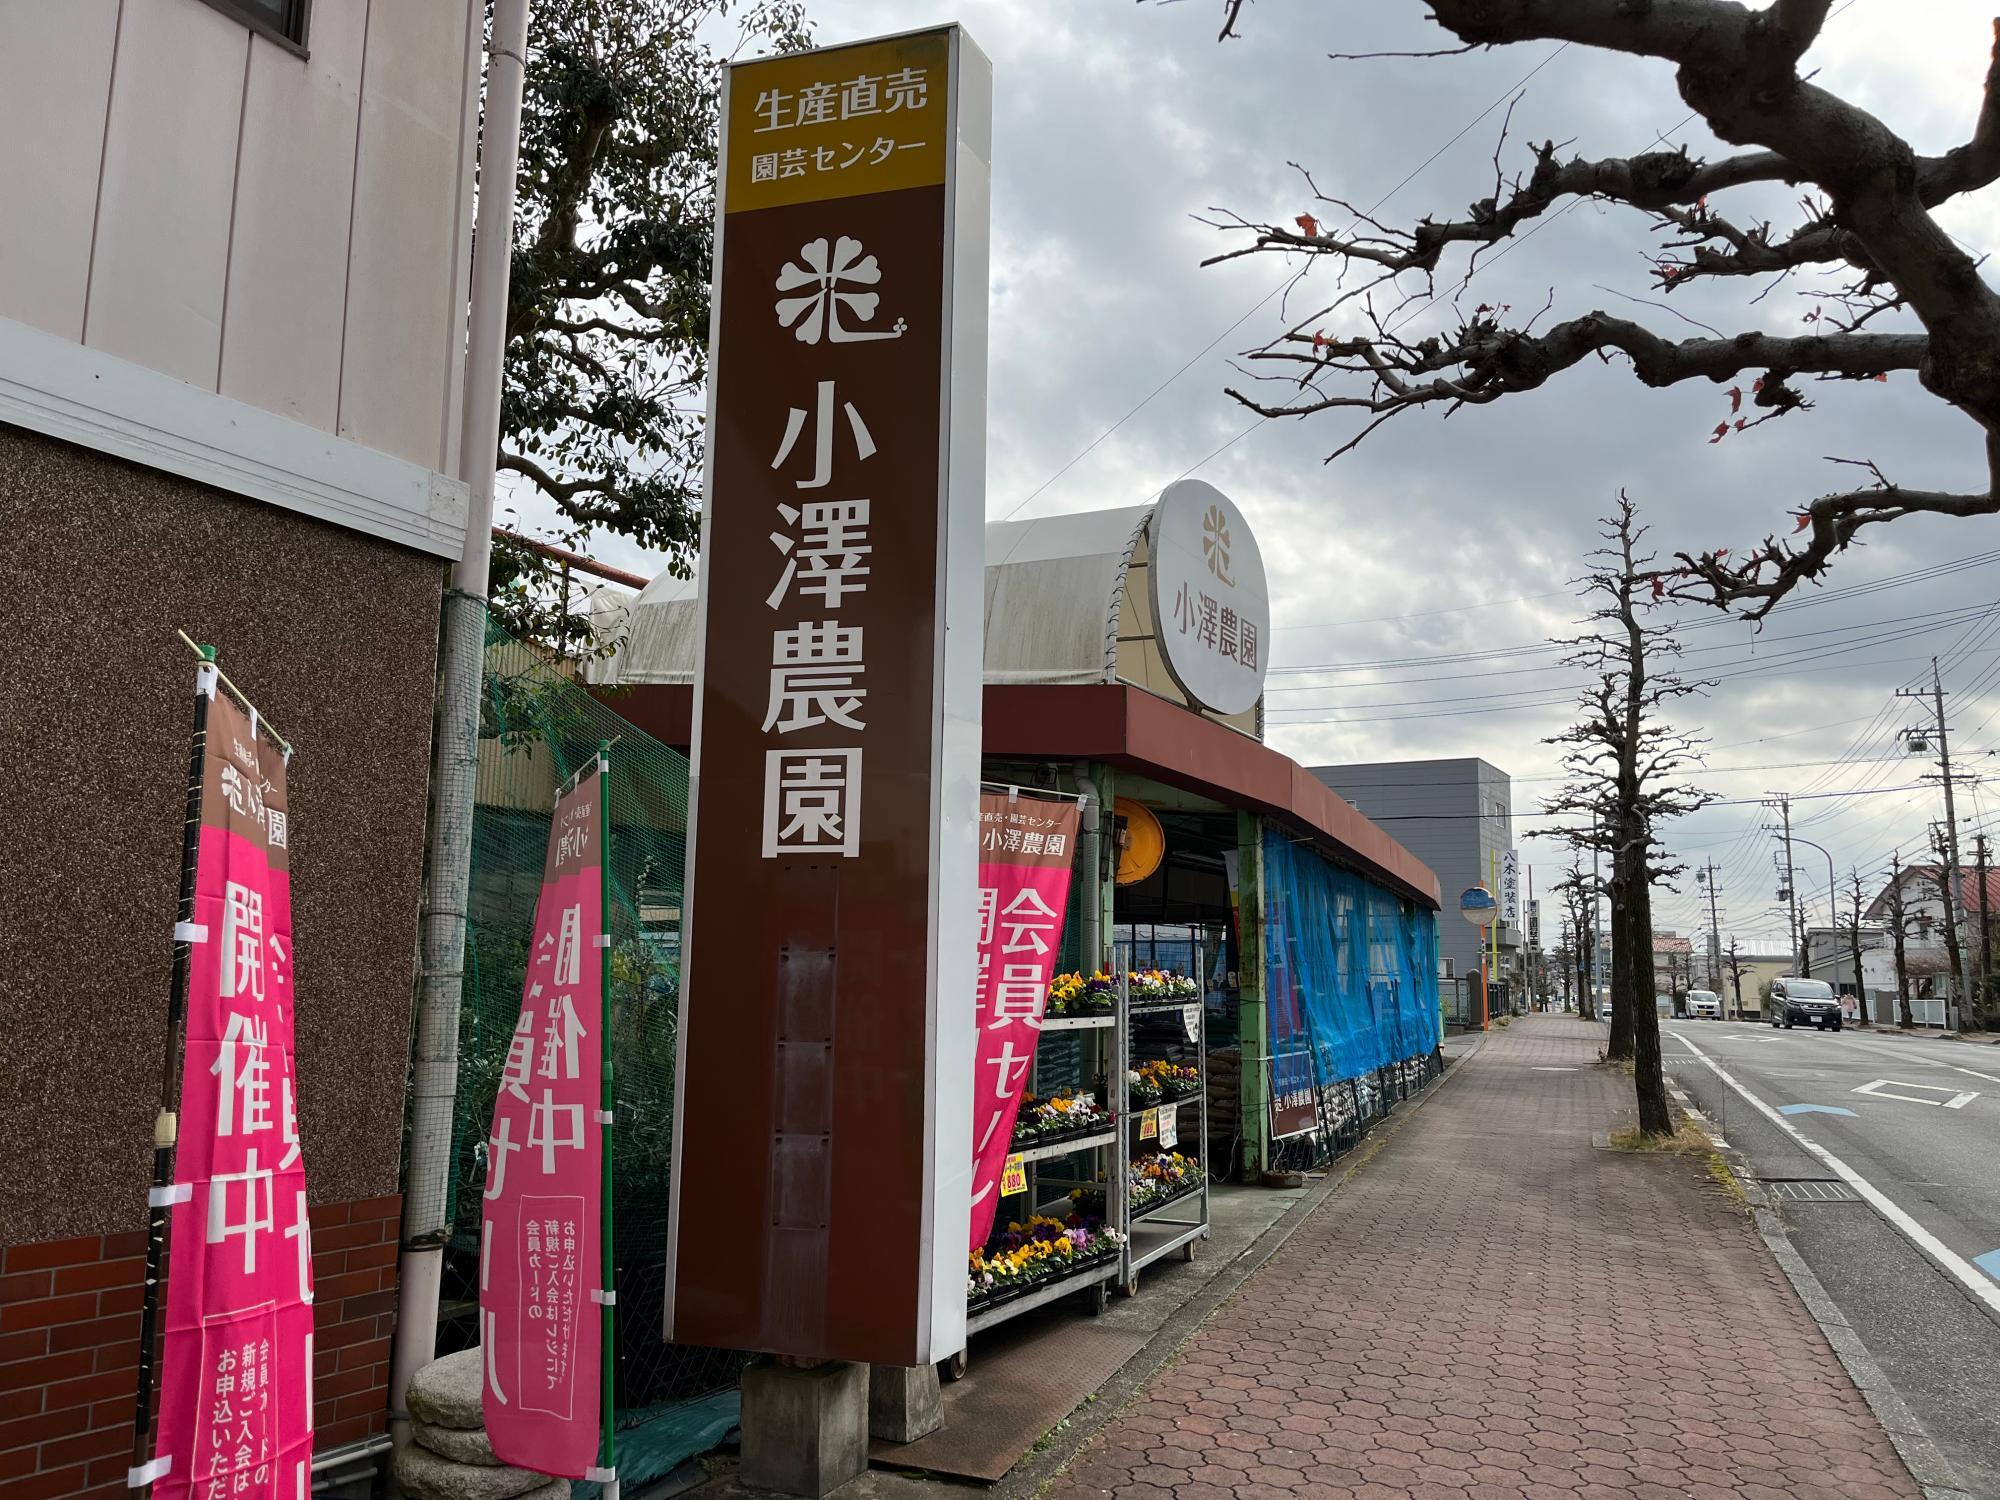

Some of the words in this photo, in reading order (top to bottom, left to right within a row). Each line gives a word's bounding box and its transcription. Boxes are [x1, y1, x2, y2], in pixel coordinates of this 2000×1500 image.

[753, 67, 928, 133] 生産直売
[751, 136, 927, 184] 園芸センター
[761, 380, 877, 859] 小澤農園
[1173, 581, 1258, 673] 小澤農園
[982, 827, 1067, 857] 小澤農園
[1503, 851, 1517, 919] 八木塗装店
[206, 879, 275, 1276] 開催中
[233, 1341, 257, 1500] 新規ご入会は
[254, 1338, 270, 1485] 会員カードの
